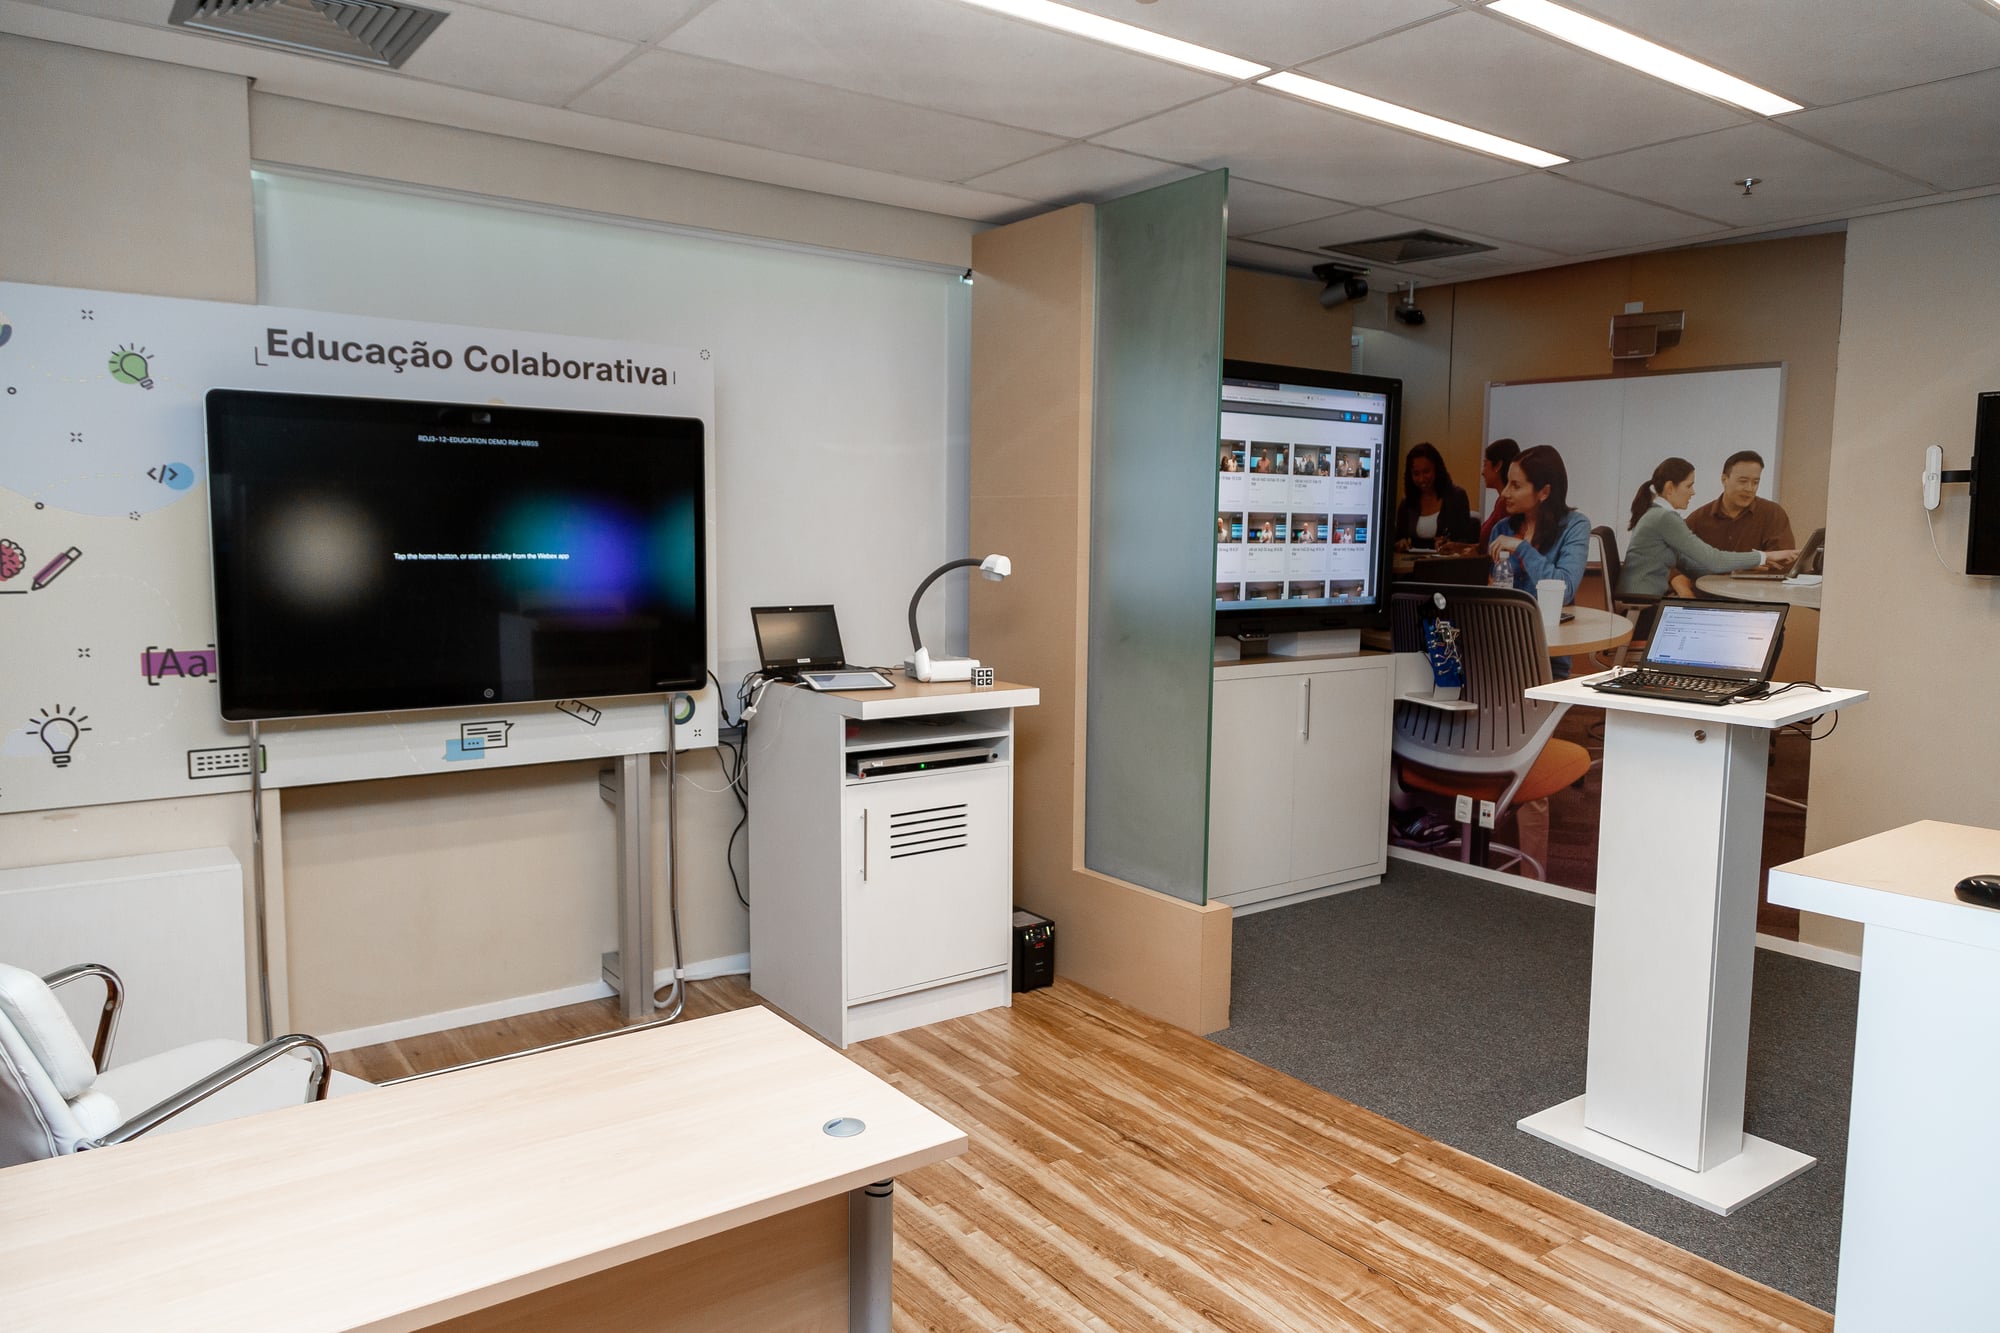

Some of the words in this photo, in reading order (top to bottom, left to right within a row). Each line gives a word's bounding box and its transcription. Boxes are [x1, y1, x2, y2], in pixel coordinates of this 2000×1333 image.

[266, 328, 453, 373] Educação
[463, 345, 668, 386] Colaborativa
[488, 438, 507, 446] DEMO
[393, 553, 406, 561] Tap
[491, 553, 511, 561] activity
